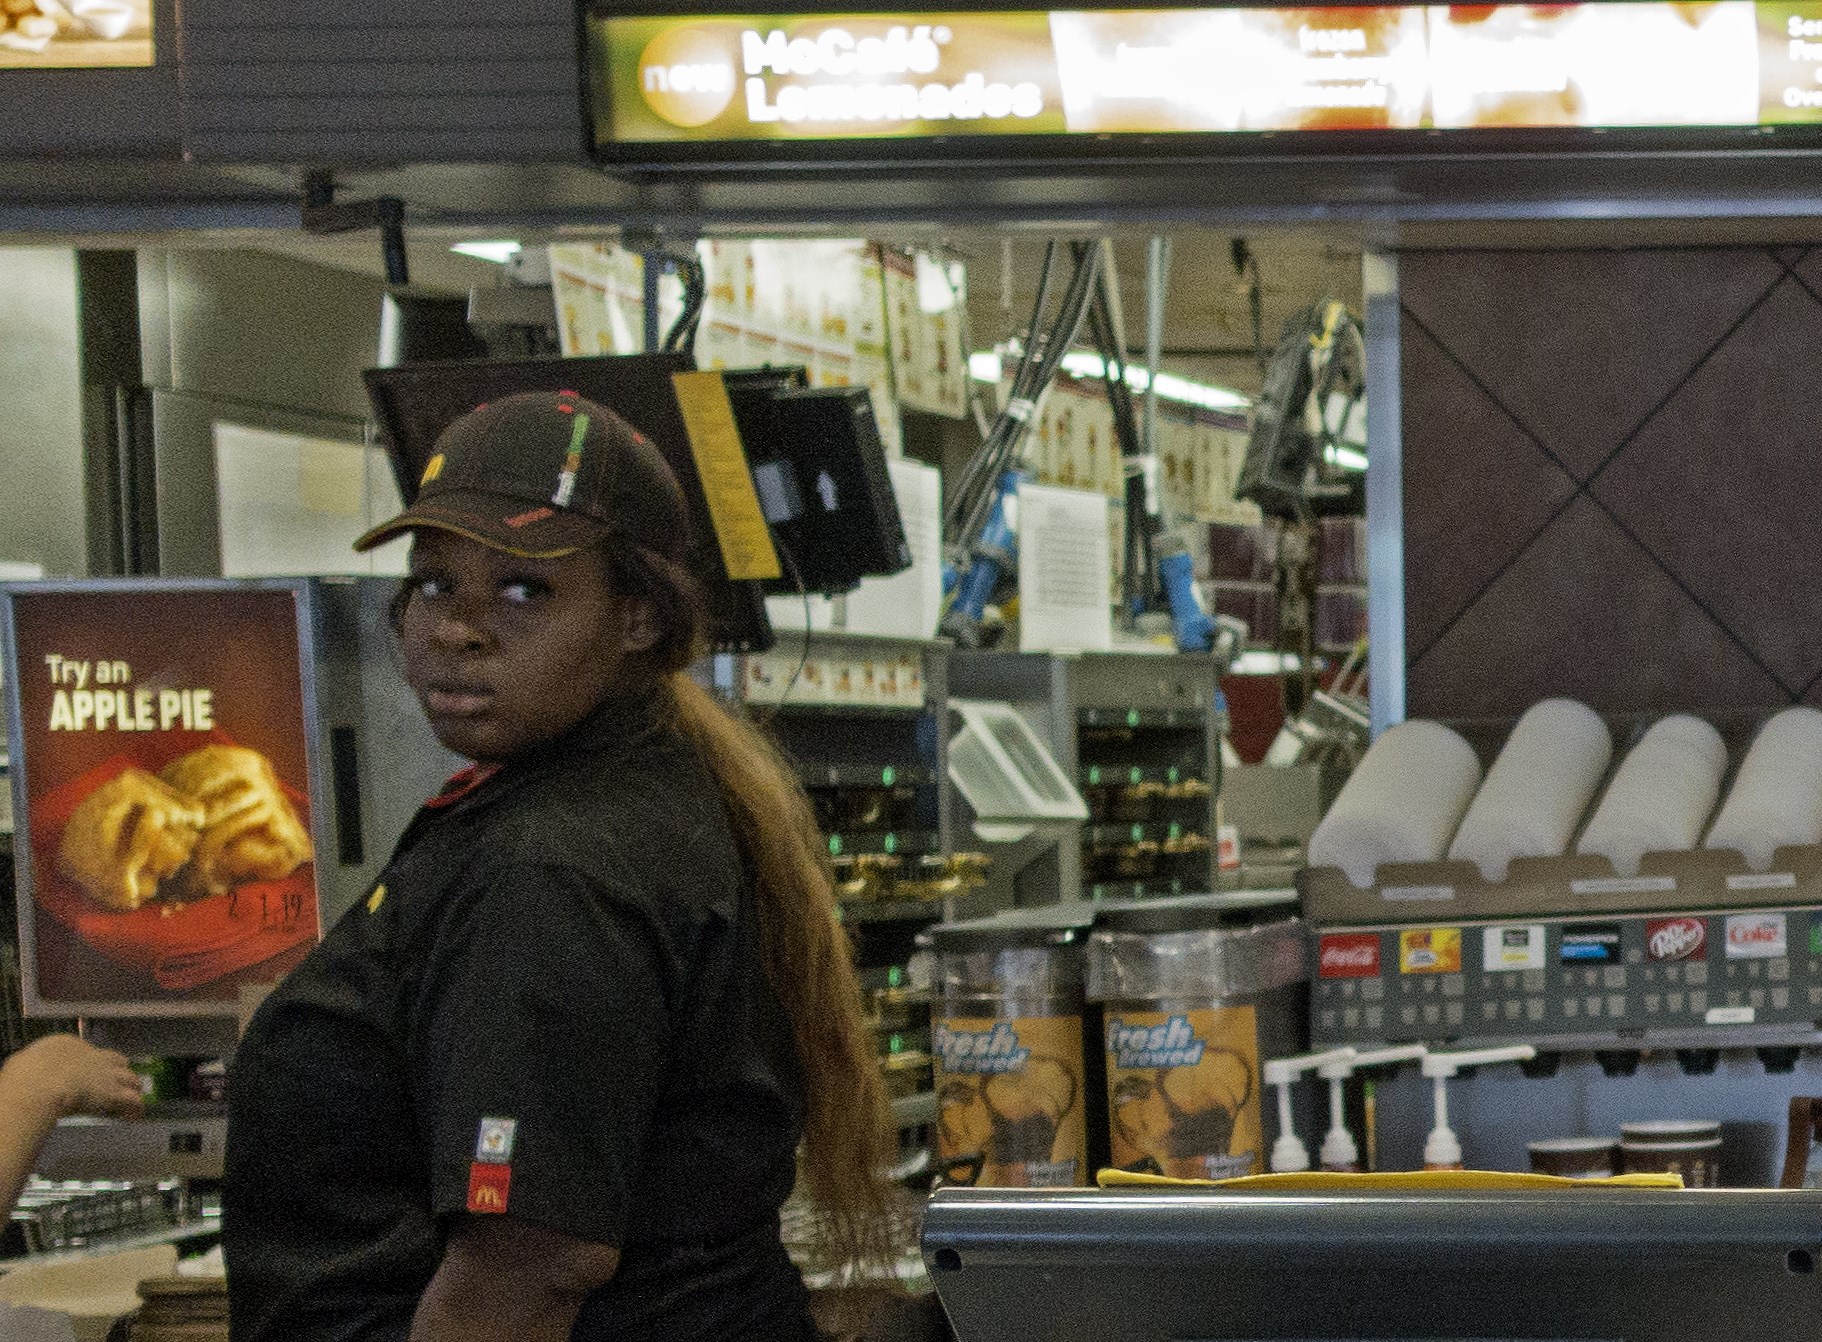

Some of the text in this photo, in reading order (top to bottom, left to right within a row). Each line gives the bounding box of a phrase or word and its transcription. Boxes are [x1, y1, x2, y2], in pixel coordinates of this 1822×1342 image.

[45, 654, 130, 689] Try an
[50, 690, 216, 731] APPLE PIE
